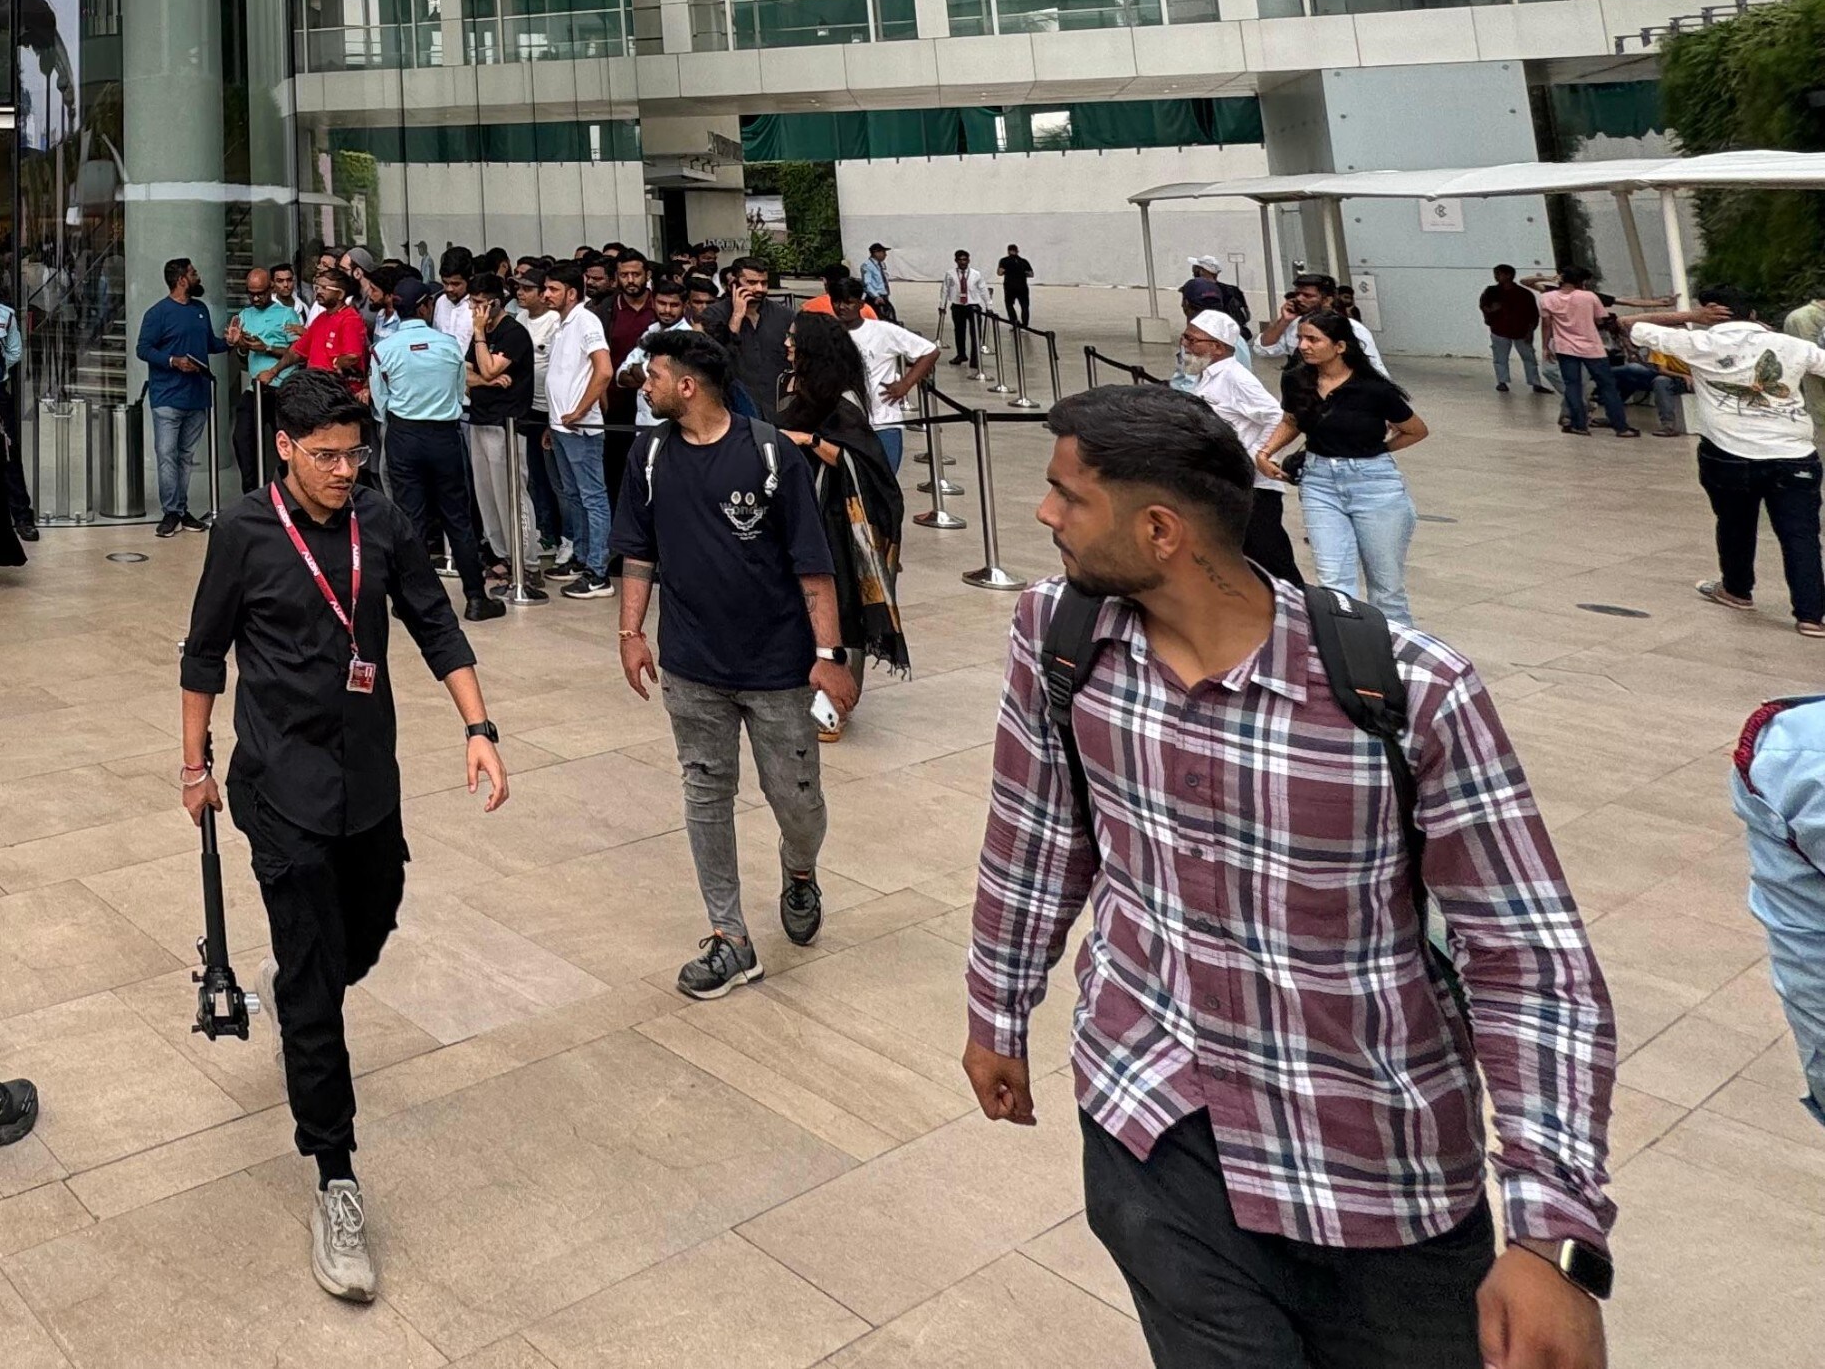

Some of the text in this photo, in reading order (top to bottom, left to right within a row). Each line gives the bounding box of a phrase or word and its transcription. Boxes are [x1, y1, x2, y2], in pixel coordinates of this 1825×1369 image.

[719, 502, 769, 516] Wondr
[302, 550, 321, 577] NDTV
[352, 543, 361, 571] NDTV
[329, 600, 349, 626] NDTV
